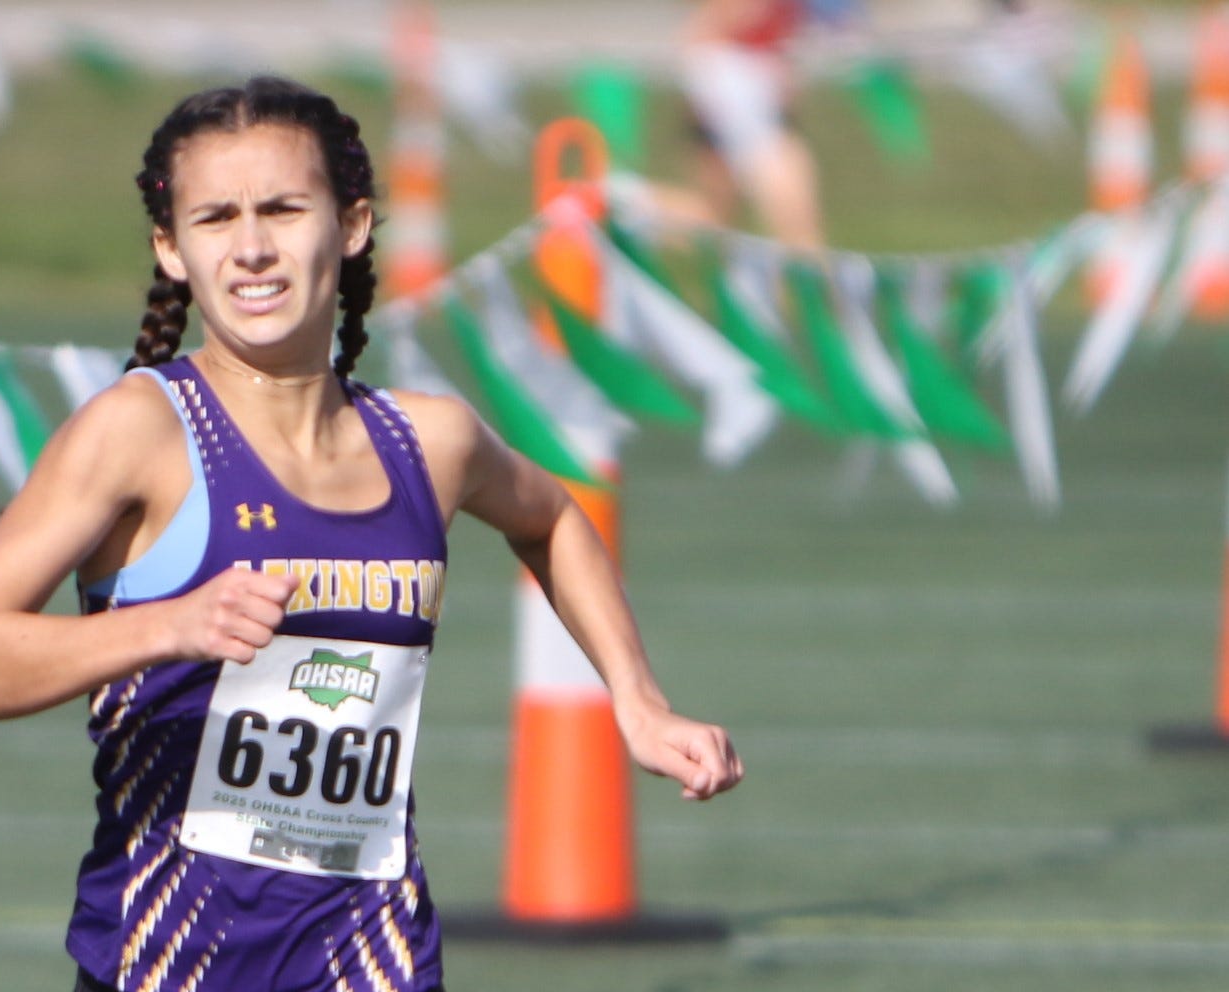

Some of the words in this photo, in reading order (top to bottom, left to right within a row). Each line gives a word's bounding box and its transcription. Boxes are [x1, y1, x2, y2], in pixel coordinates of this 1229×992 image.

[234, 558, 446, 627] XINGTO
[293, 662, 376, 699] OHSAA
[217, 709, 401, 807] 6360
[213, 791, 246, 807] 2025
[251, 800, 302, 819] OHSAA
[306, 808, 343, 823] Cross
[348, 813, 389, 828] Country
[236, 812, 273, 829] State
